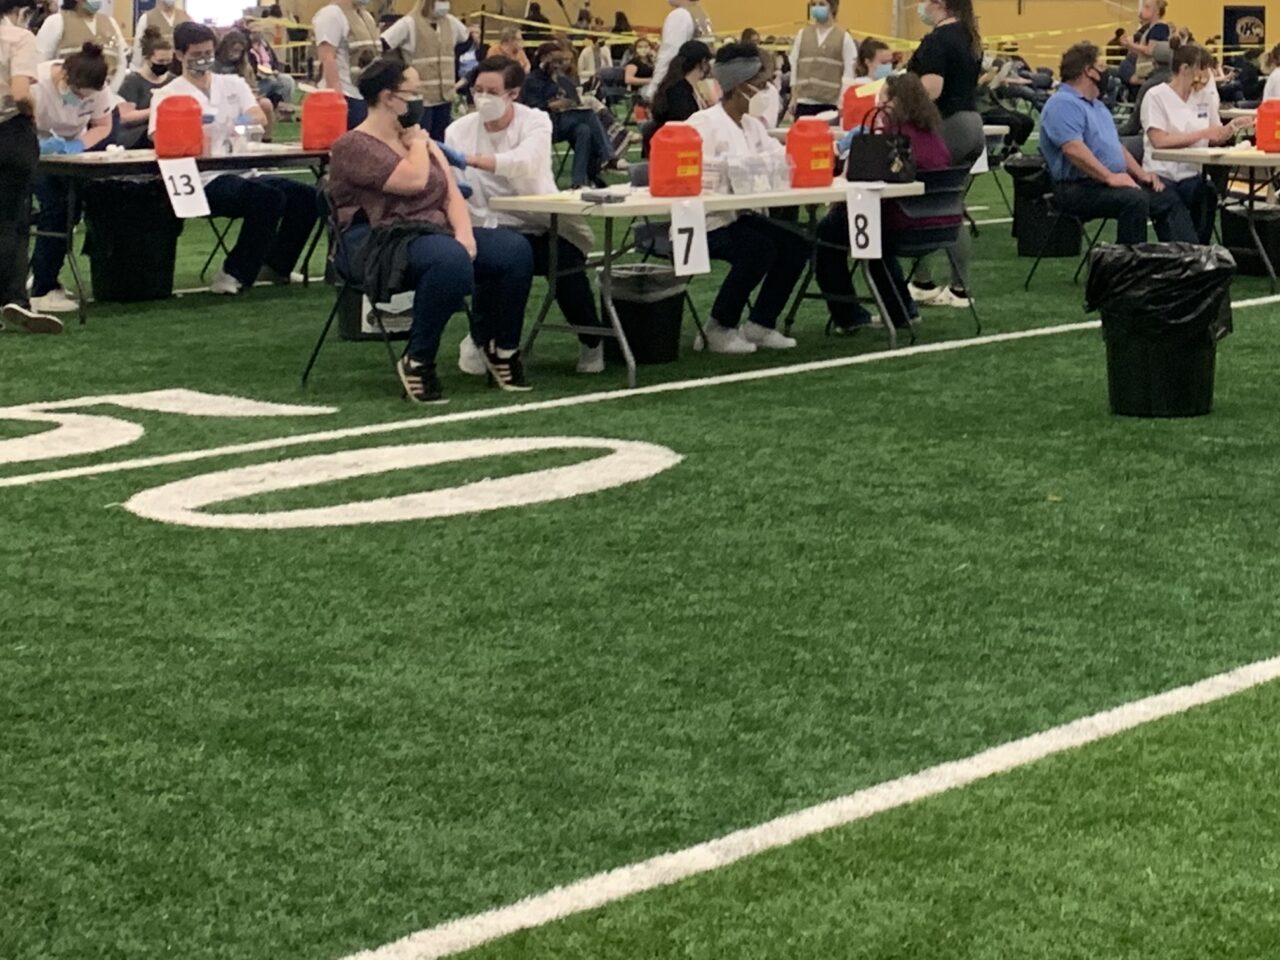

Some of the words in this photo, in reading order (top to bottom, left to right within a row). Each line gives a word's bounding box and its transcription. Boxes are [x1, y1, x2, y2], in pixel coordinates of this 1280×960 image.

[168, 174, 196, 196] 13
[677, 227, 695, 266] 7
[854, 213, 870, 250] 8
